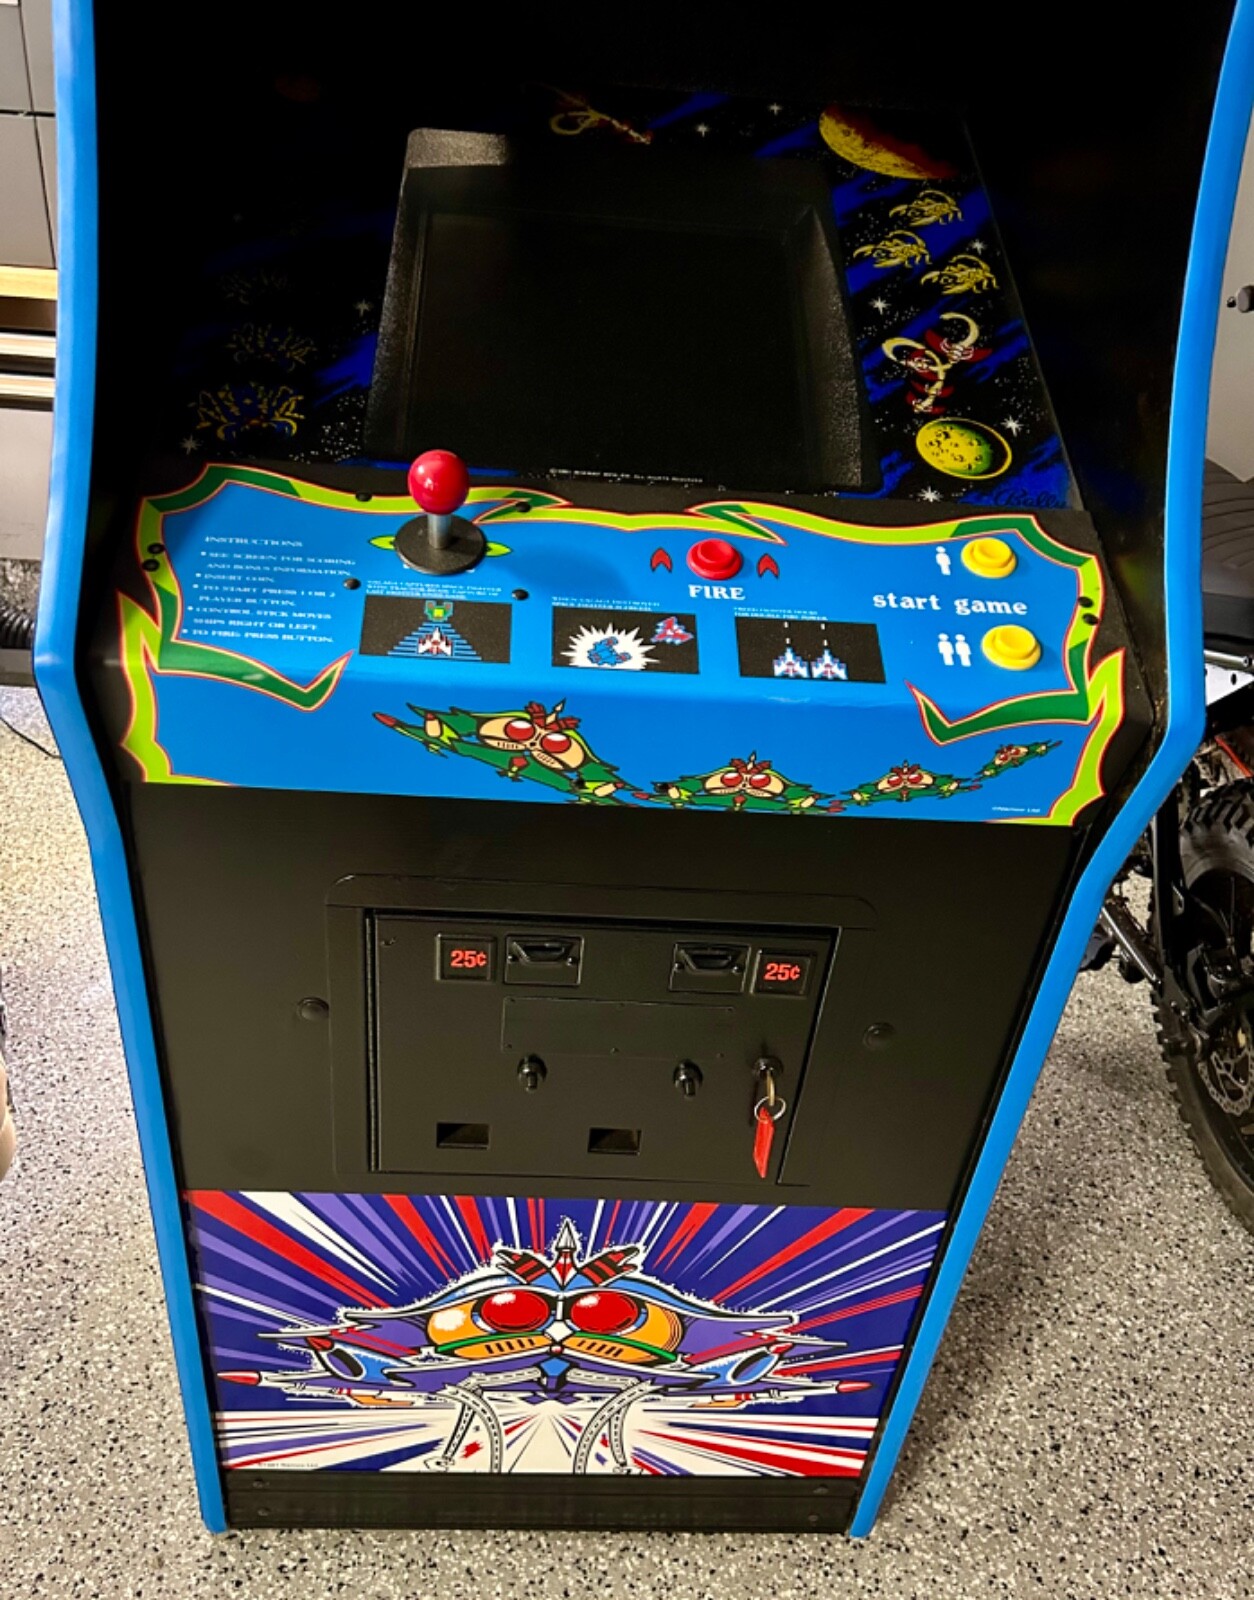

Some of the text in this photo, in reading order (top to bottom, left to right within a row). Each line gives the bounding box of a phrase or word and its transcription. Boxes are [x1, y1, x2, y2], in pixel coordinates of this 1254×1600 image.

[204, 535, 303, 548] INSTRUCTIONS
[688, 584, 746, 600] FIRE
[872, 592, 1028, 616] start game
[450, 949, 487, 968] 25¢
[764, 962, 801, 981] 25¢
